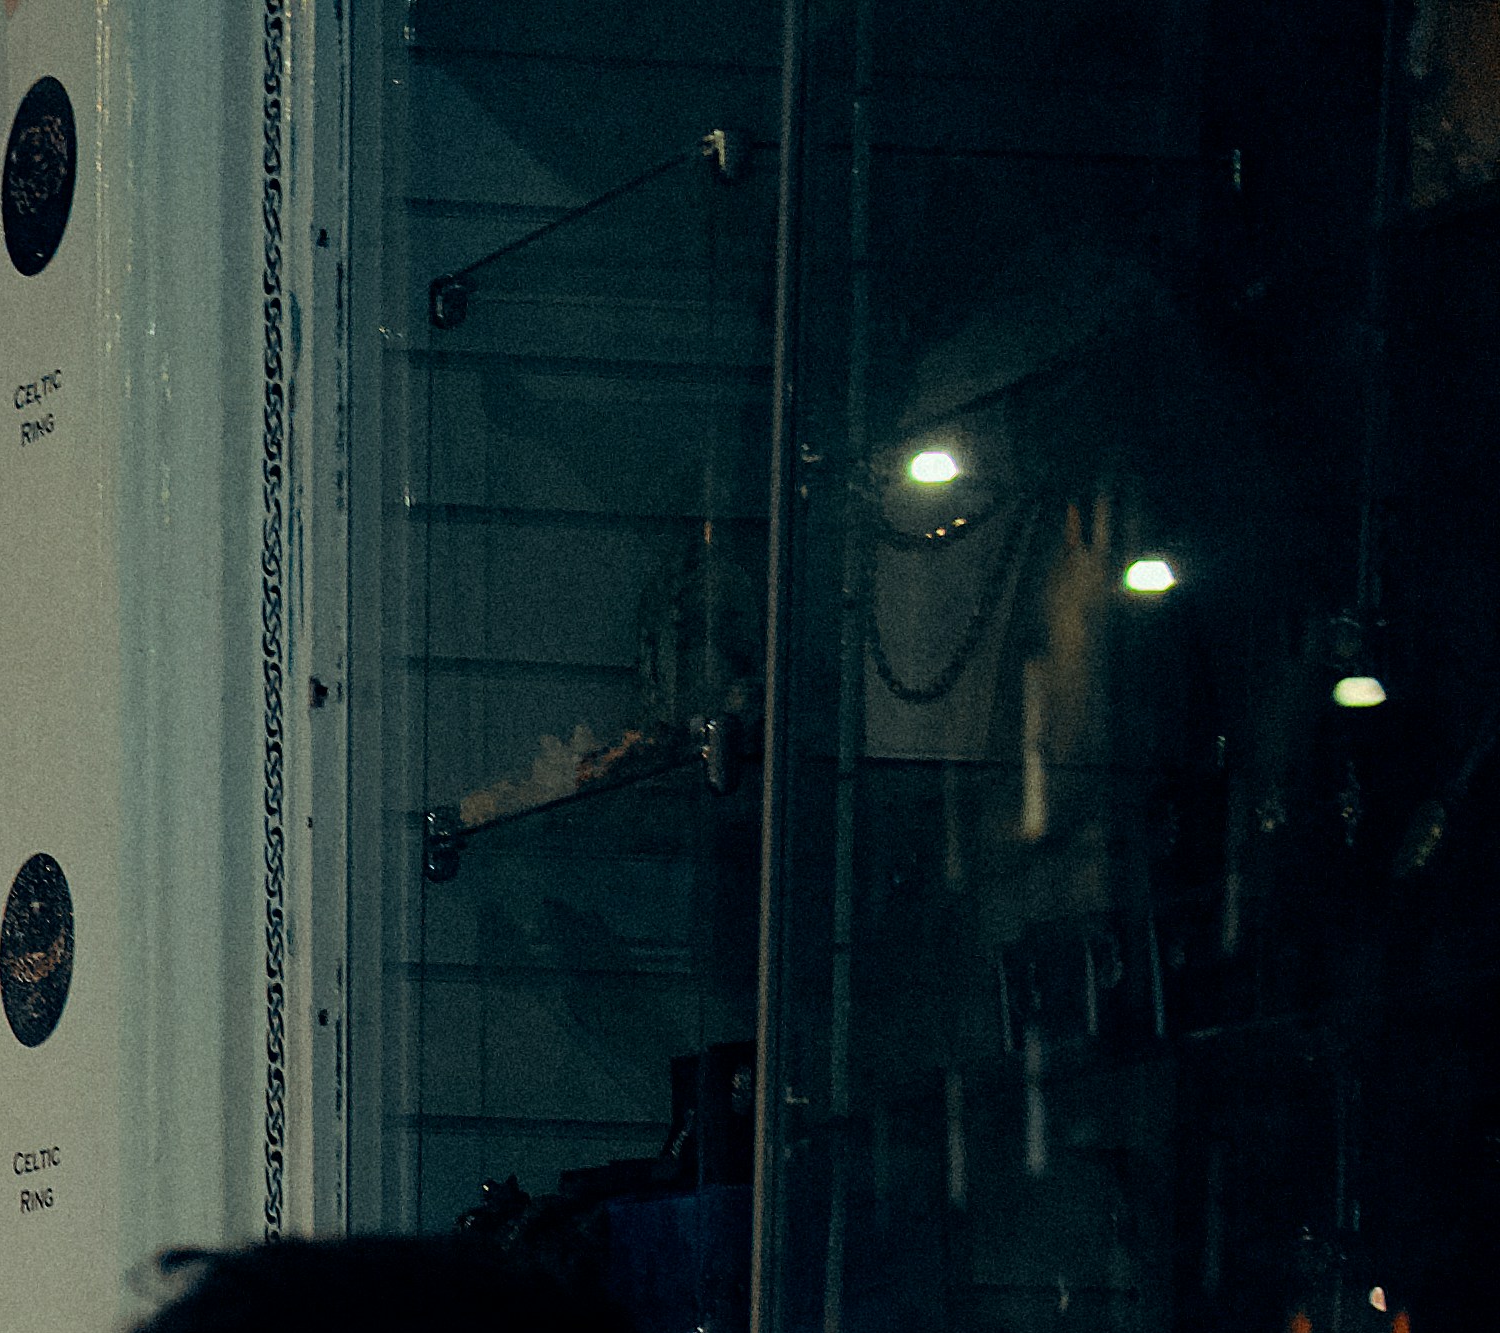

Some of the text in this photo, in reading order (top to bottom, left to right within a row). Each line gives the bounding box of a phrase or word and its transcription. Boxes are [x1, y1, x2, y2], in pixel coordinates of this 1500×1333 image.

[13, 369, 62, 409] CELTIC
[20, 413, 55, 446] RING
[13, 1146, 60, 1174] CELTIC
[21, 1187, 53, 1214] RING
